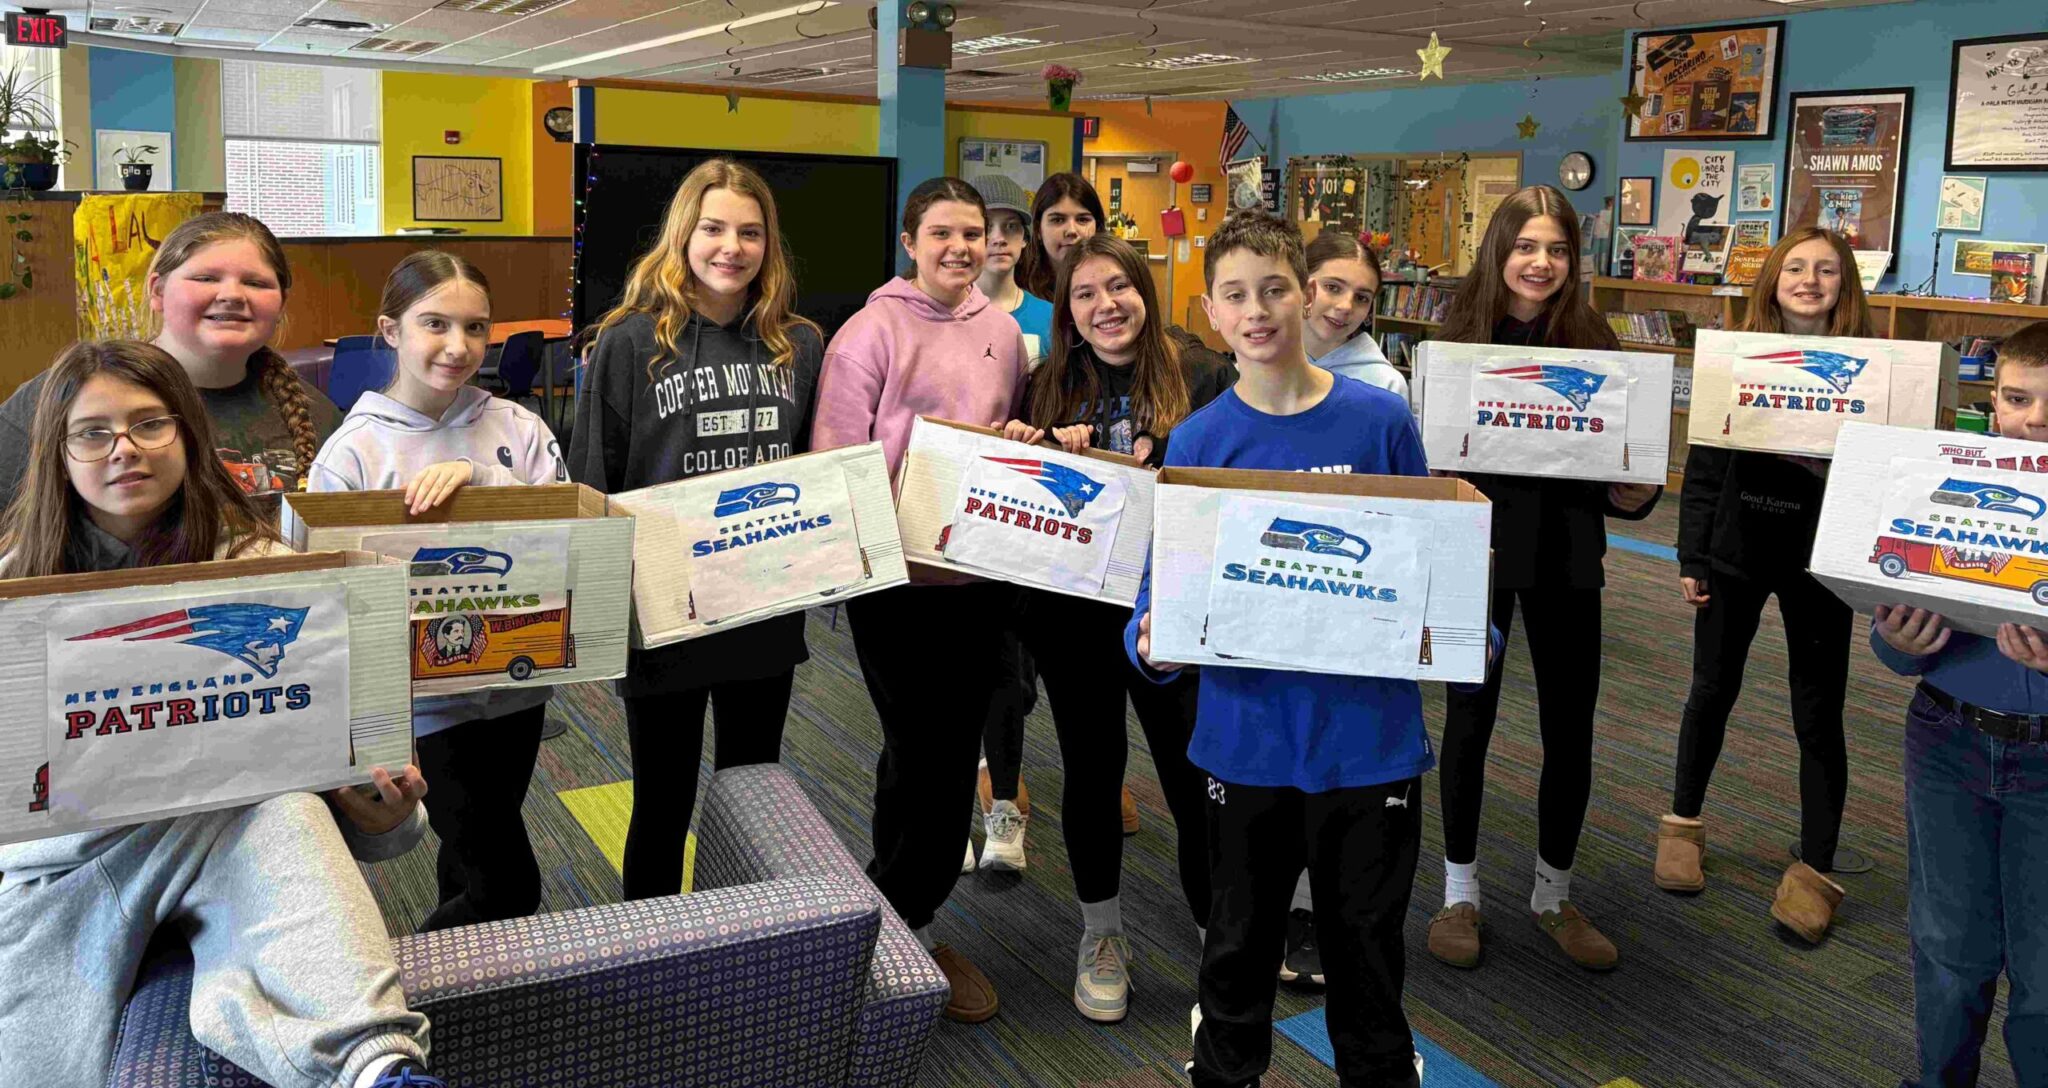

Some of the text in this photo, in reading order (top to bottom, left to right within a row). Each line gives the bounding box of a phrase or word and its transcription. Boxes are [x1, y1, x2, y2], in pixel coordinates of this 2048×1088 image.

[17, 16, 56, 43] EXIT
[1084, 119, 1093, 135] IT
[1705, 156, 1726, 164] CITY
[1809, 154, 1884, 172] SHAWN AMOS
[1322, 178, 1338, 195] 101
[1701, 180, 1720, 188] CITY
[1824, 190, 1858, 200] Cookies
[1828, 200, 1852, 208] & Milk
[1740, 383, 1834, 394] NEW ENGLAND
[1478, 400, 1574, 412] NEW ENGLAND
[1738, 392, 1865, 414] PATRIOTS
[702, 411, 773, 432] EST. 177
[1476, 410, 1604, 433] PATRIOTS
[1942, 446, 1985, 459] WHO BUT
[970, 486, 1065, 517] NEW ENGLAND
[1740, 490, 1801, 510] Good Karma
[1750, 504, 1786, 514] STUDIO
[720, 510, 802, 535] SEATTLE
[964, 496, 1093, 544] PATRIOTS
[1928, 514, 2039, 536] SEATTLE
[692, 514, 832, 558] SEAHAWKS
[1260, 557, 1364, 580] SEATTLE
[410, 584, 508, 596] SEATTLE
[1222, 562, 1398, 602] SEAHAWKS
[414, 594, 541, 615] AHAWKS
[64, 672, 254, 706] NEW ENGLAND
[64, 683, 312, 740] PATRIOTS
[1207, 776, 1226, 805] 83
